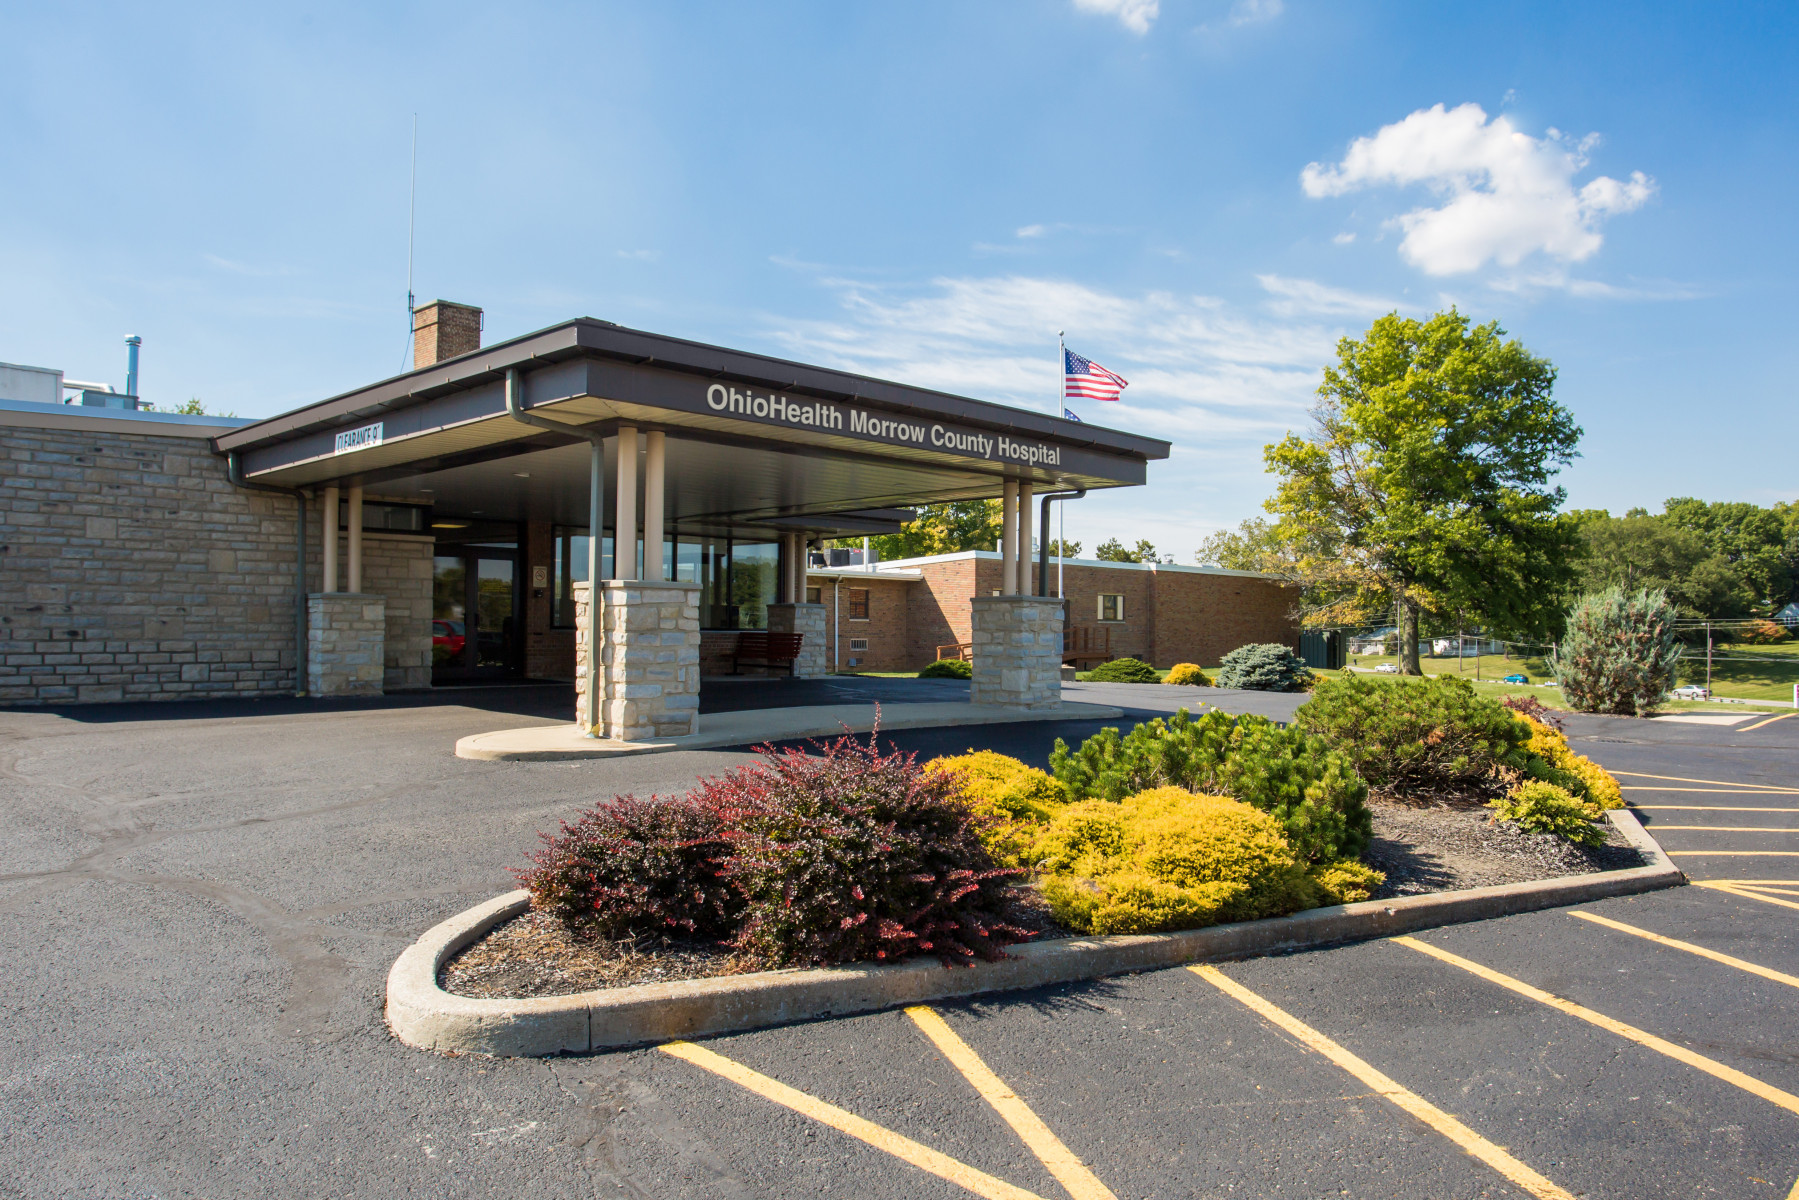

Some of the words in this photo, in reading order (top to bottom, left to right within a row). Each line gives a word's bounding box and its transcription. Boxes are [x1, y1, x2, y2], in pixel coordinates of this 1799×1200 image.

[706, 384, 842, 429] OhioHealth
[850, 410, 926, 443] Morrow
[930, 424, 993, 459] County
[998, 437, 1061, 466] Hospital
